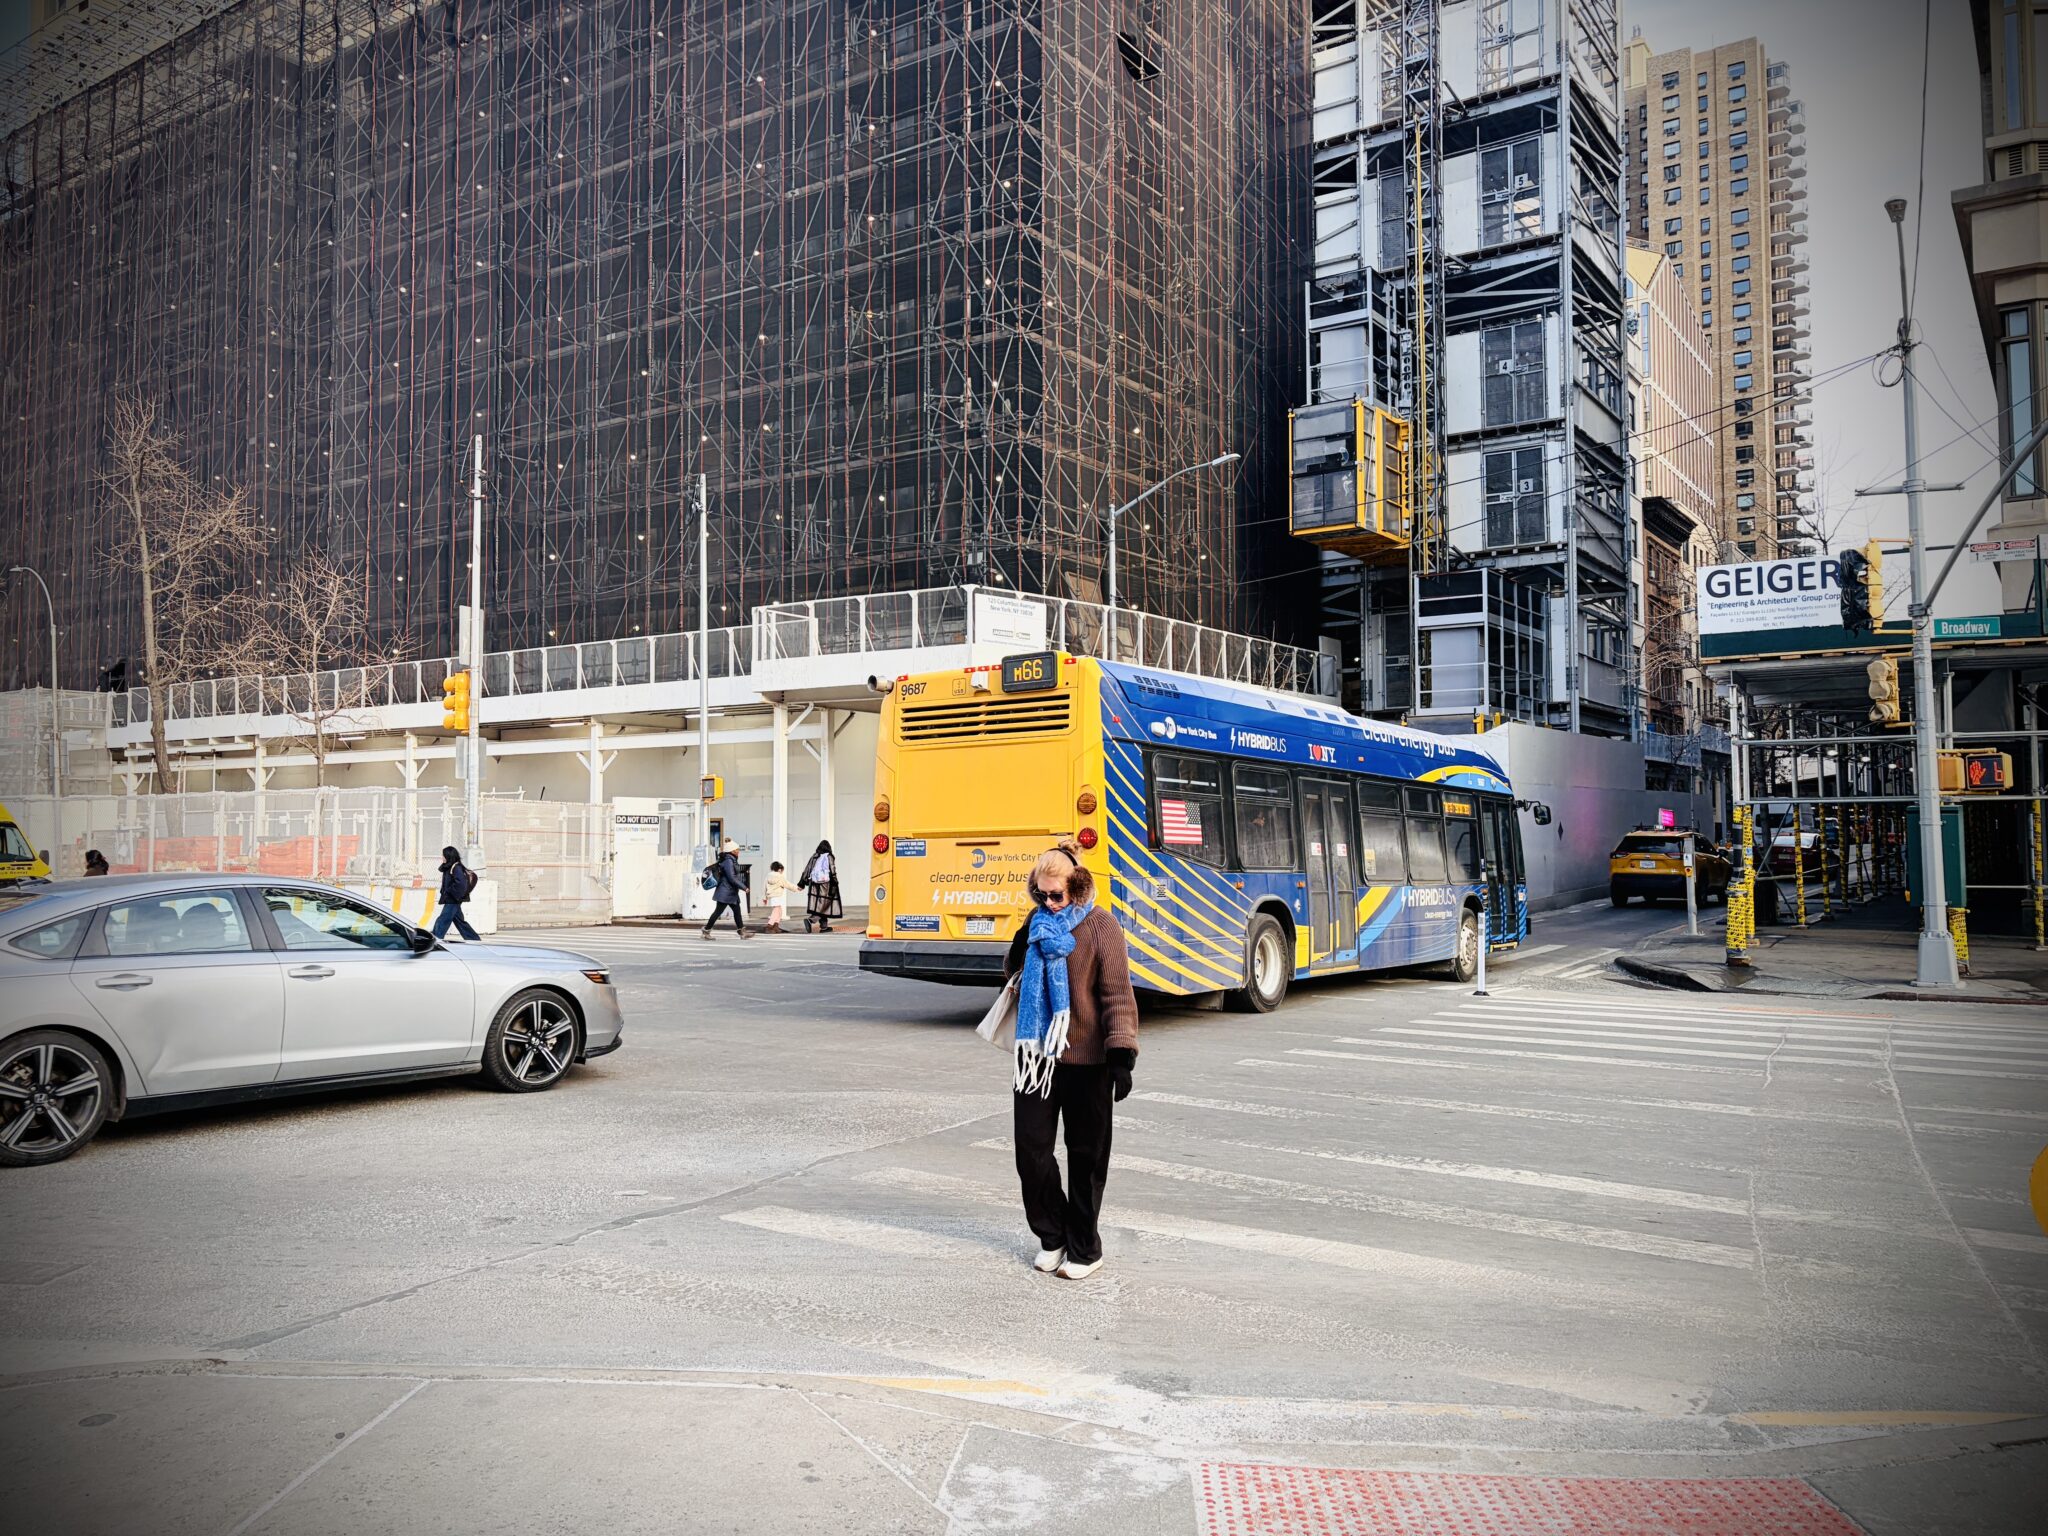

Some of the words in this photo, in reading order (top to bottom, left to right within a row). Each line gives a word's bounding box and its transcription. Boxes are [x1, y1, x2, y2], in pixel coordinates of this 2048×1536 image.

[1498, 24, 1504, 33] 6
[1518, 176, 1524, 186] 5
[1502, 361, 1508, 370] 4
[1524, 481, 1529, 491] 3
[1705, 559, 1841, 598] GEIGER
[1801, 594, 1823, 603] Group
[1941, 621, 1990, 636] Broadway
[1014, 658, 1043, 682] M66
[901, 682, 927, 696] 9687
[1177, 724, 1187, 734] New
[1187, 726, 1198, 736] York
[1198, 728, 1207, 740] City
[1208, 730, 1217, 740] Bus
[640, 816, 658, 824] ENTER
[987, 854, 1002, 862] New
[1004, 854, 1019, 862] York
[1021, 853, 1036, 863] City
[930, 871, 1005, 885] clean-energy
[1007, 870, 1028, 883] bus
